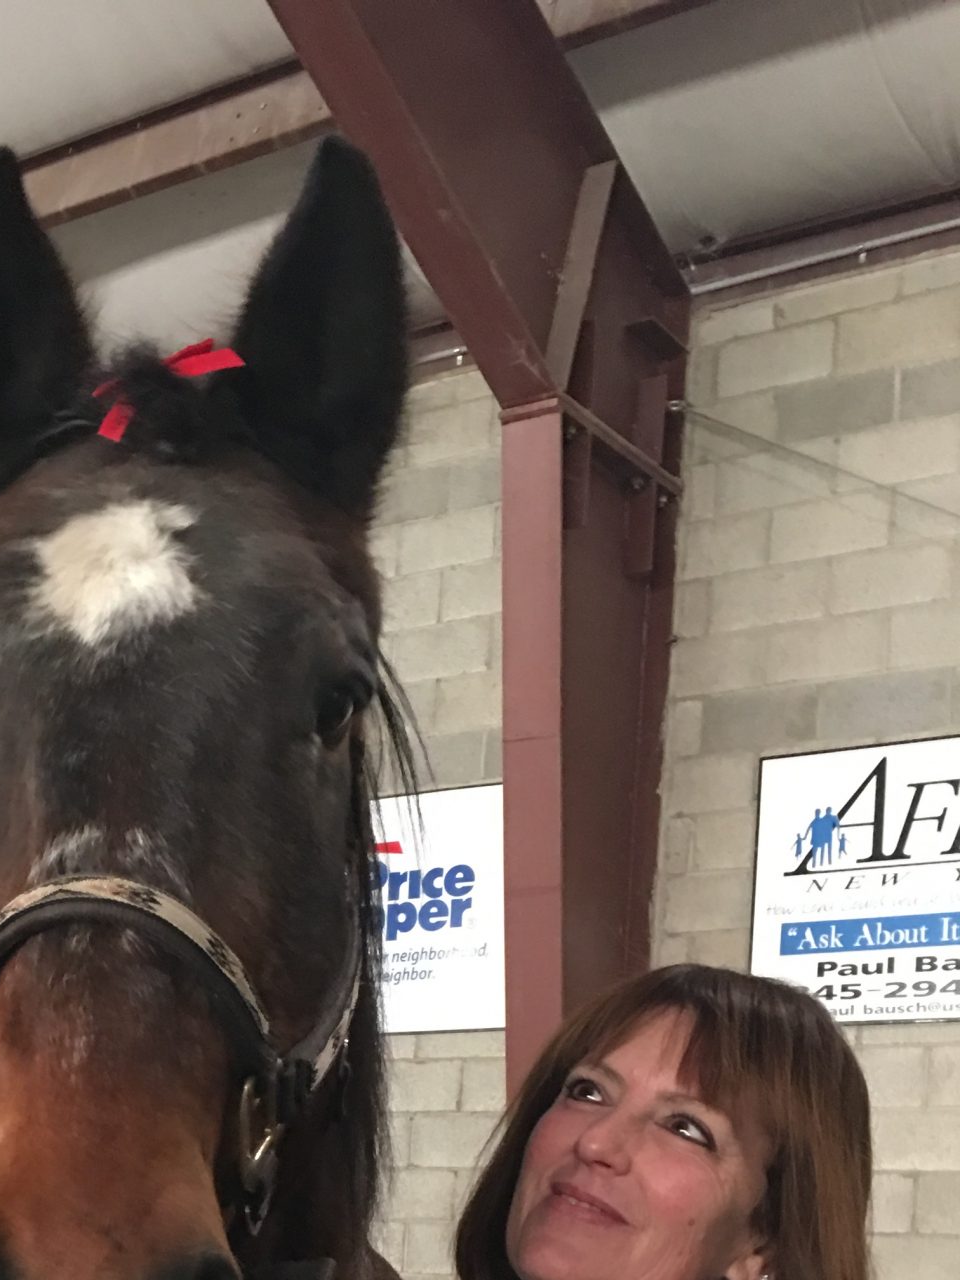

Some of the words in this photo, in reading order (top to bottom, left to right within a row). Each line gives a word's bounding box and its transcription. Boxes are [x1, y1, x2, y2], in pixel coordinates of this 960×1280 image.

[805, 872, 910, 893] NEW
[853, 921, 929, 947] About
[381, 967, 436, 986] eighbor.
[817, 956, 895, 978] Paul
[915, 955, 960, 973] Ba
[828, 1005, 854, 1017] aul
